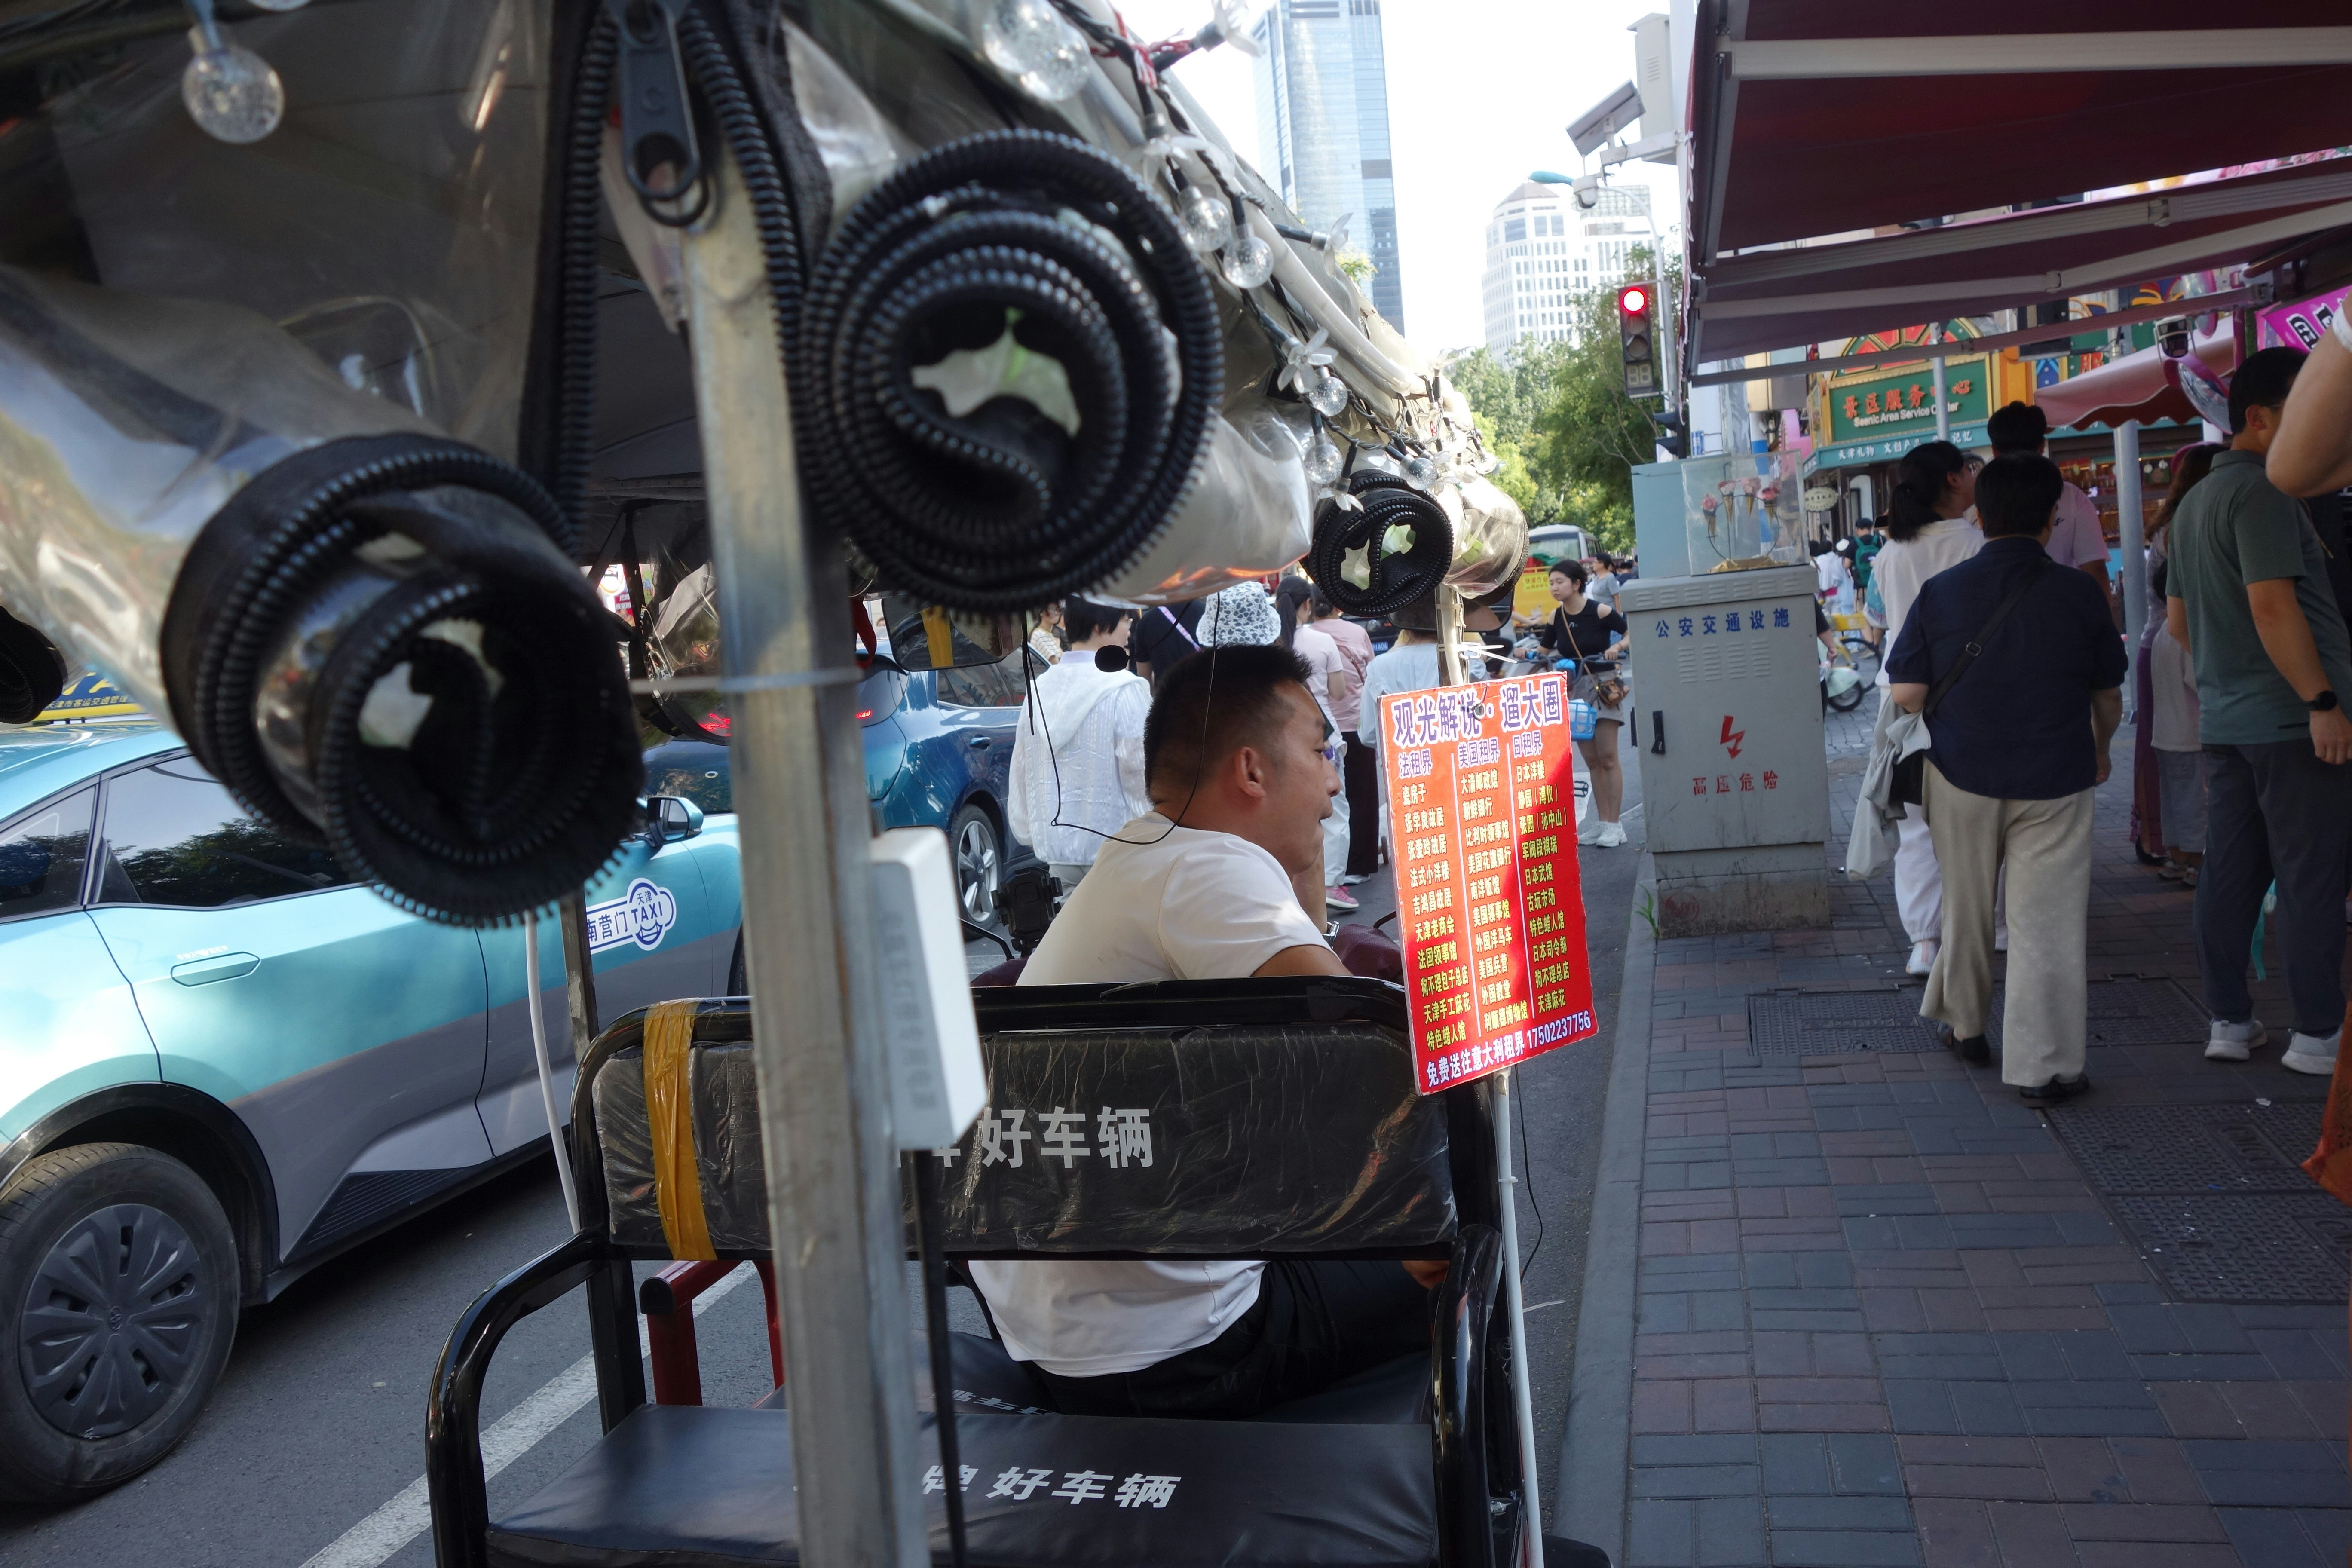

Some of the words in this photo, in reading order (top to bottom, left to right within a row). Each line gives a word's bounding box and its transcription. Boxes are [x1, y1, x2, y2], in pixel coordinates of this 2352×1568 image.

[1854, 413, 1880, 427] Scenic
[1880, 412, 1899, 424] Area
[1900, 407, 1930, 420] Service
[1931, 402, 1959, 415] Cter
[1838, 445, 1874, 460] 天津礼物
[1656, 607, 1791, 638] 公安交通设施
[1458, 738, 1500, 768] 美国租界
[1513, 731, 1542, 758] 日租界
[1399, 749, 1432, 779] 法租界
[1516, 760, 1545, 783] 日本洋楼
[1402, 782, 1426, 807] 瓷房子
[1461, 769, 1498, 795] 大清邮政馆
[1693, 770, 1779, 796] 高压危险
[1404, 806, 1445, 834] 张学良故居
[1463, 796, 1493, 821] 朝鲜银行
[1407, 833, 1447, 861] 张爱玲故居
[1465, 819, 1510, 847] 比利时领事馆
[1468, 845, 1512, 875] 美国花旗银行
[1525, 862, 1553, 886] 日本武馆
[1410, 860, 1450, 889] 法式小洋楼
[1470, 874, 1501, 901] 南洋饭馆
[637, 891, 652, 905] 天津
[1412, 886, 1452, 916] 吉鸿昌故居
[1527, 887, 1556, 912] 古玩市场
[631, 902, 663, 924] TAXI
[1473, 899, 1510, 928] 美国领事馆
[1529, 910, 1565, 937] 特色蜡人馆
[1415, 914, 1455, 943] 天津老商会
[1475, 925, 1513, 953] 外国洋马车
[1418, 940, 1458, 970] 法国领事馆
[1533, 936, 1567, 962] 日本司令部
[1478, 952, 1508, 980] 美国兵营
[1535, 960, 1570, 989] 狗不理总店
[1421, 964, 1469, 998] 狗不理包子总店
[1481, 979, 1511, 1006] 外国教堂
[1424, 991, 1471, 1025] 天津手工麻花
[1537, 987, 1566, 1014] 天津麻花
[1484, 1000, 1528, 1032] 利顺德博物馆
[1427, 1020, 1466, 1051] 特色蜡人馆
[1427, 1030, 1525, 1088] 免费送往意大利租界
[1527, 1010, 1591, 1049] 17502237756
